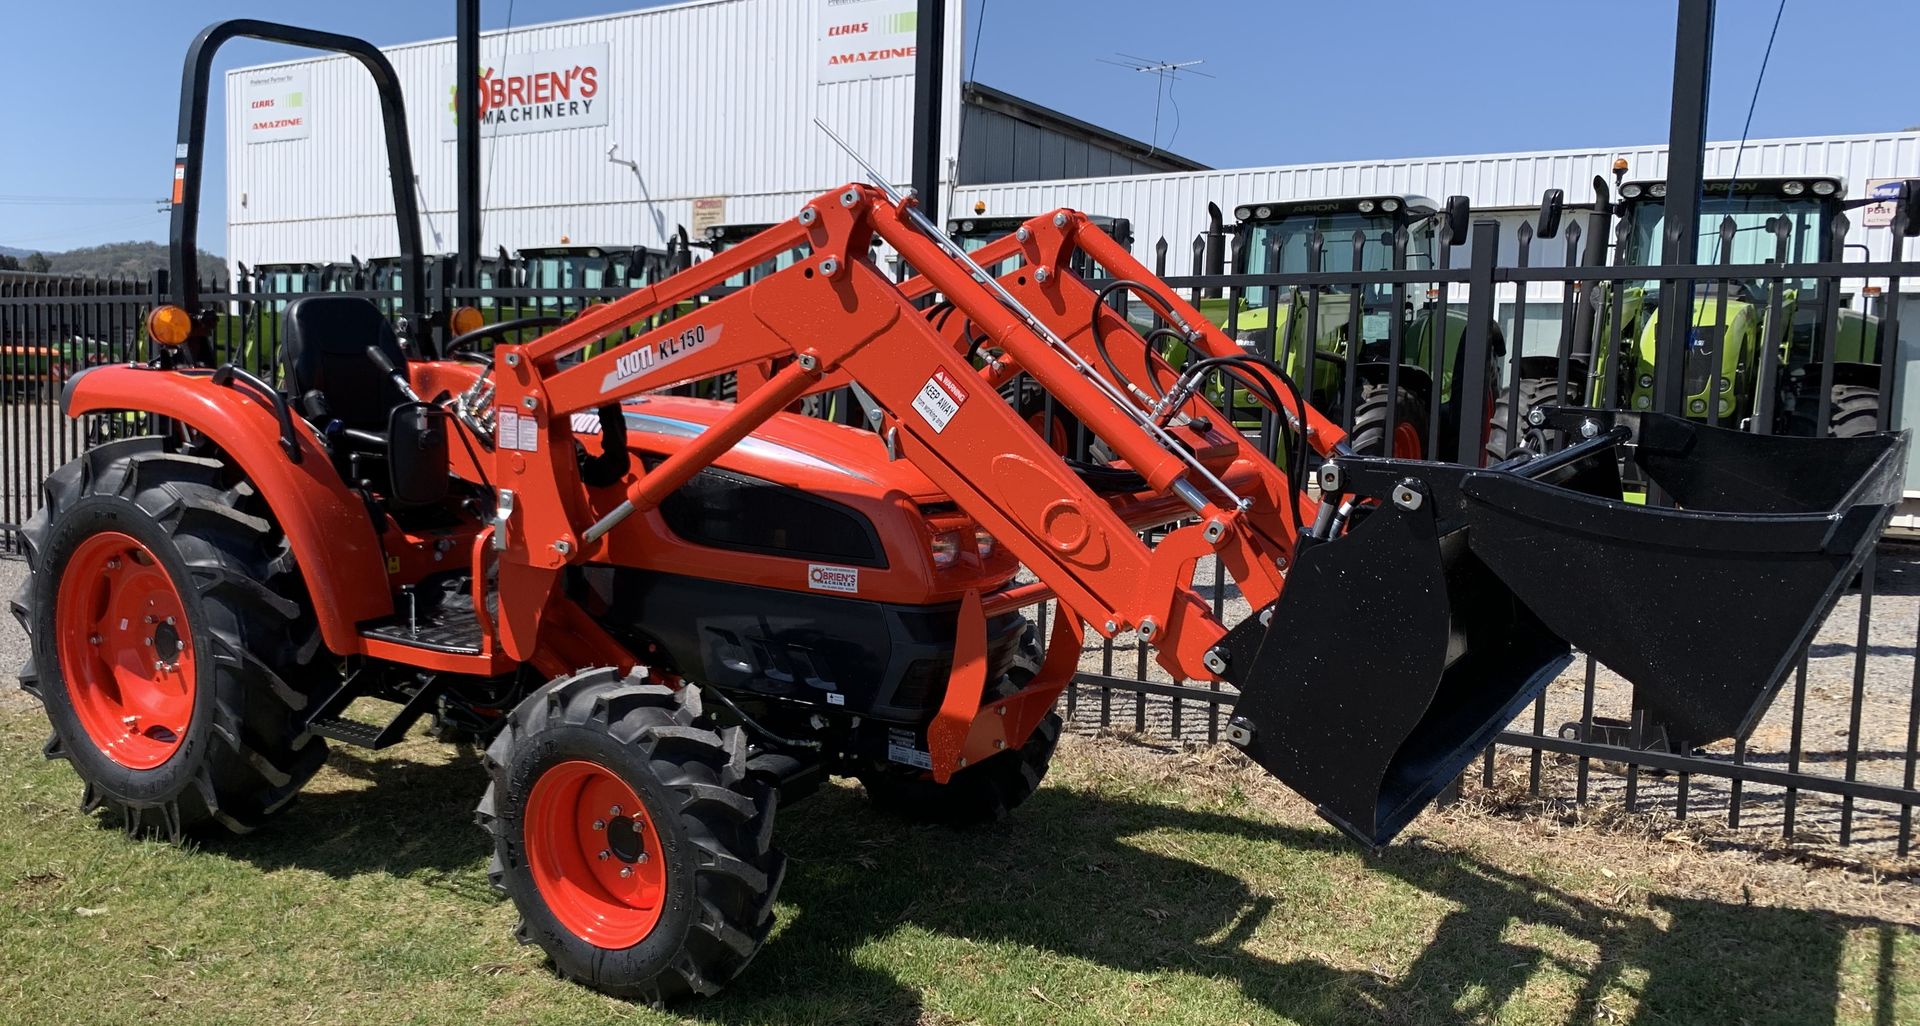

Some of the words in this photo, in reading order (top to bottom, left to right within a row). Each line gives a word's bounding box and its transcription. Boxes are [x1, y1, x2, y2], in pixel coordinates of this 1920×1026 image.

[828, 22, 869, 37] CLAAS
[827, 46, 917, 66] AMAZONE
[251, 99, 275, 109] CLAAS
[483, 99, 593, 125] MACHINERY
[252, 117, 304, 130] AMAZONE
[1292, 203, 1340, 213] ARION
[616, 344, 654, 380] KIOTI
[943, 376, 966, 402] WARNING
[924, 383, 941, 401] KEEP
[936, 397, 955, 417] AWAY
[811, 567, 856, 583] O'BRIEN'S
